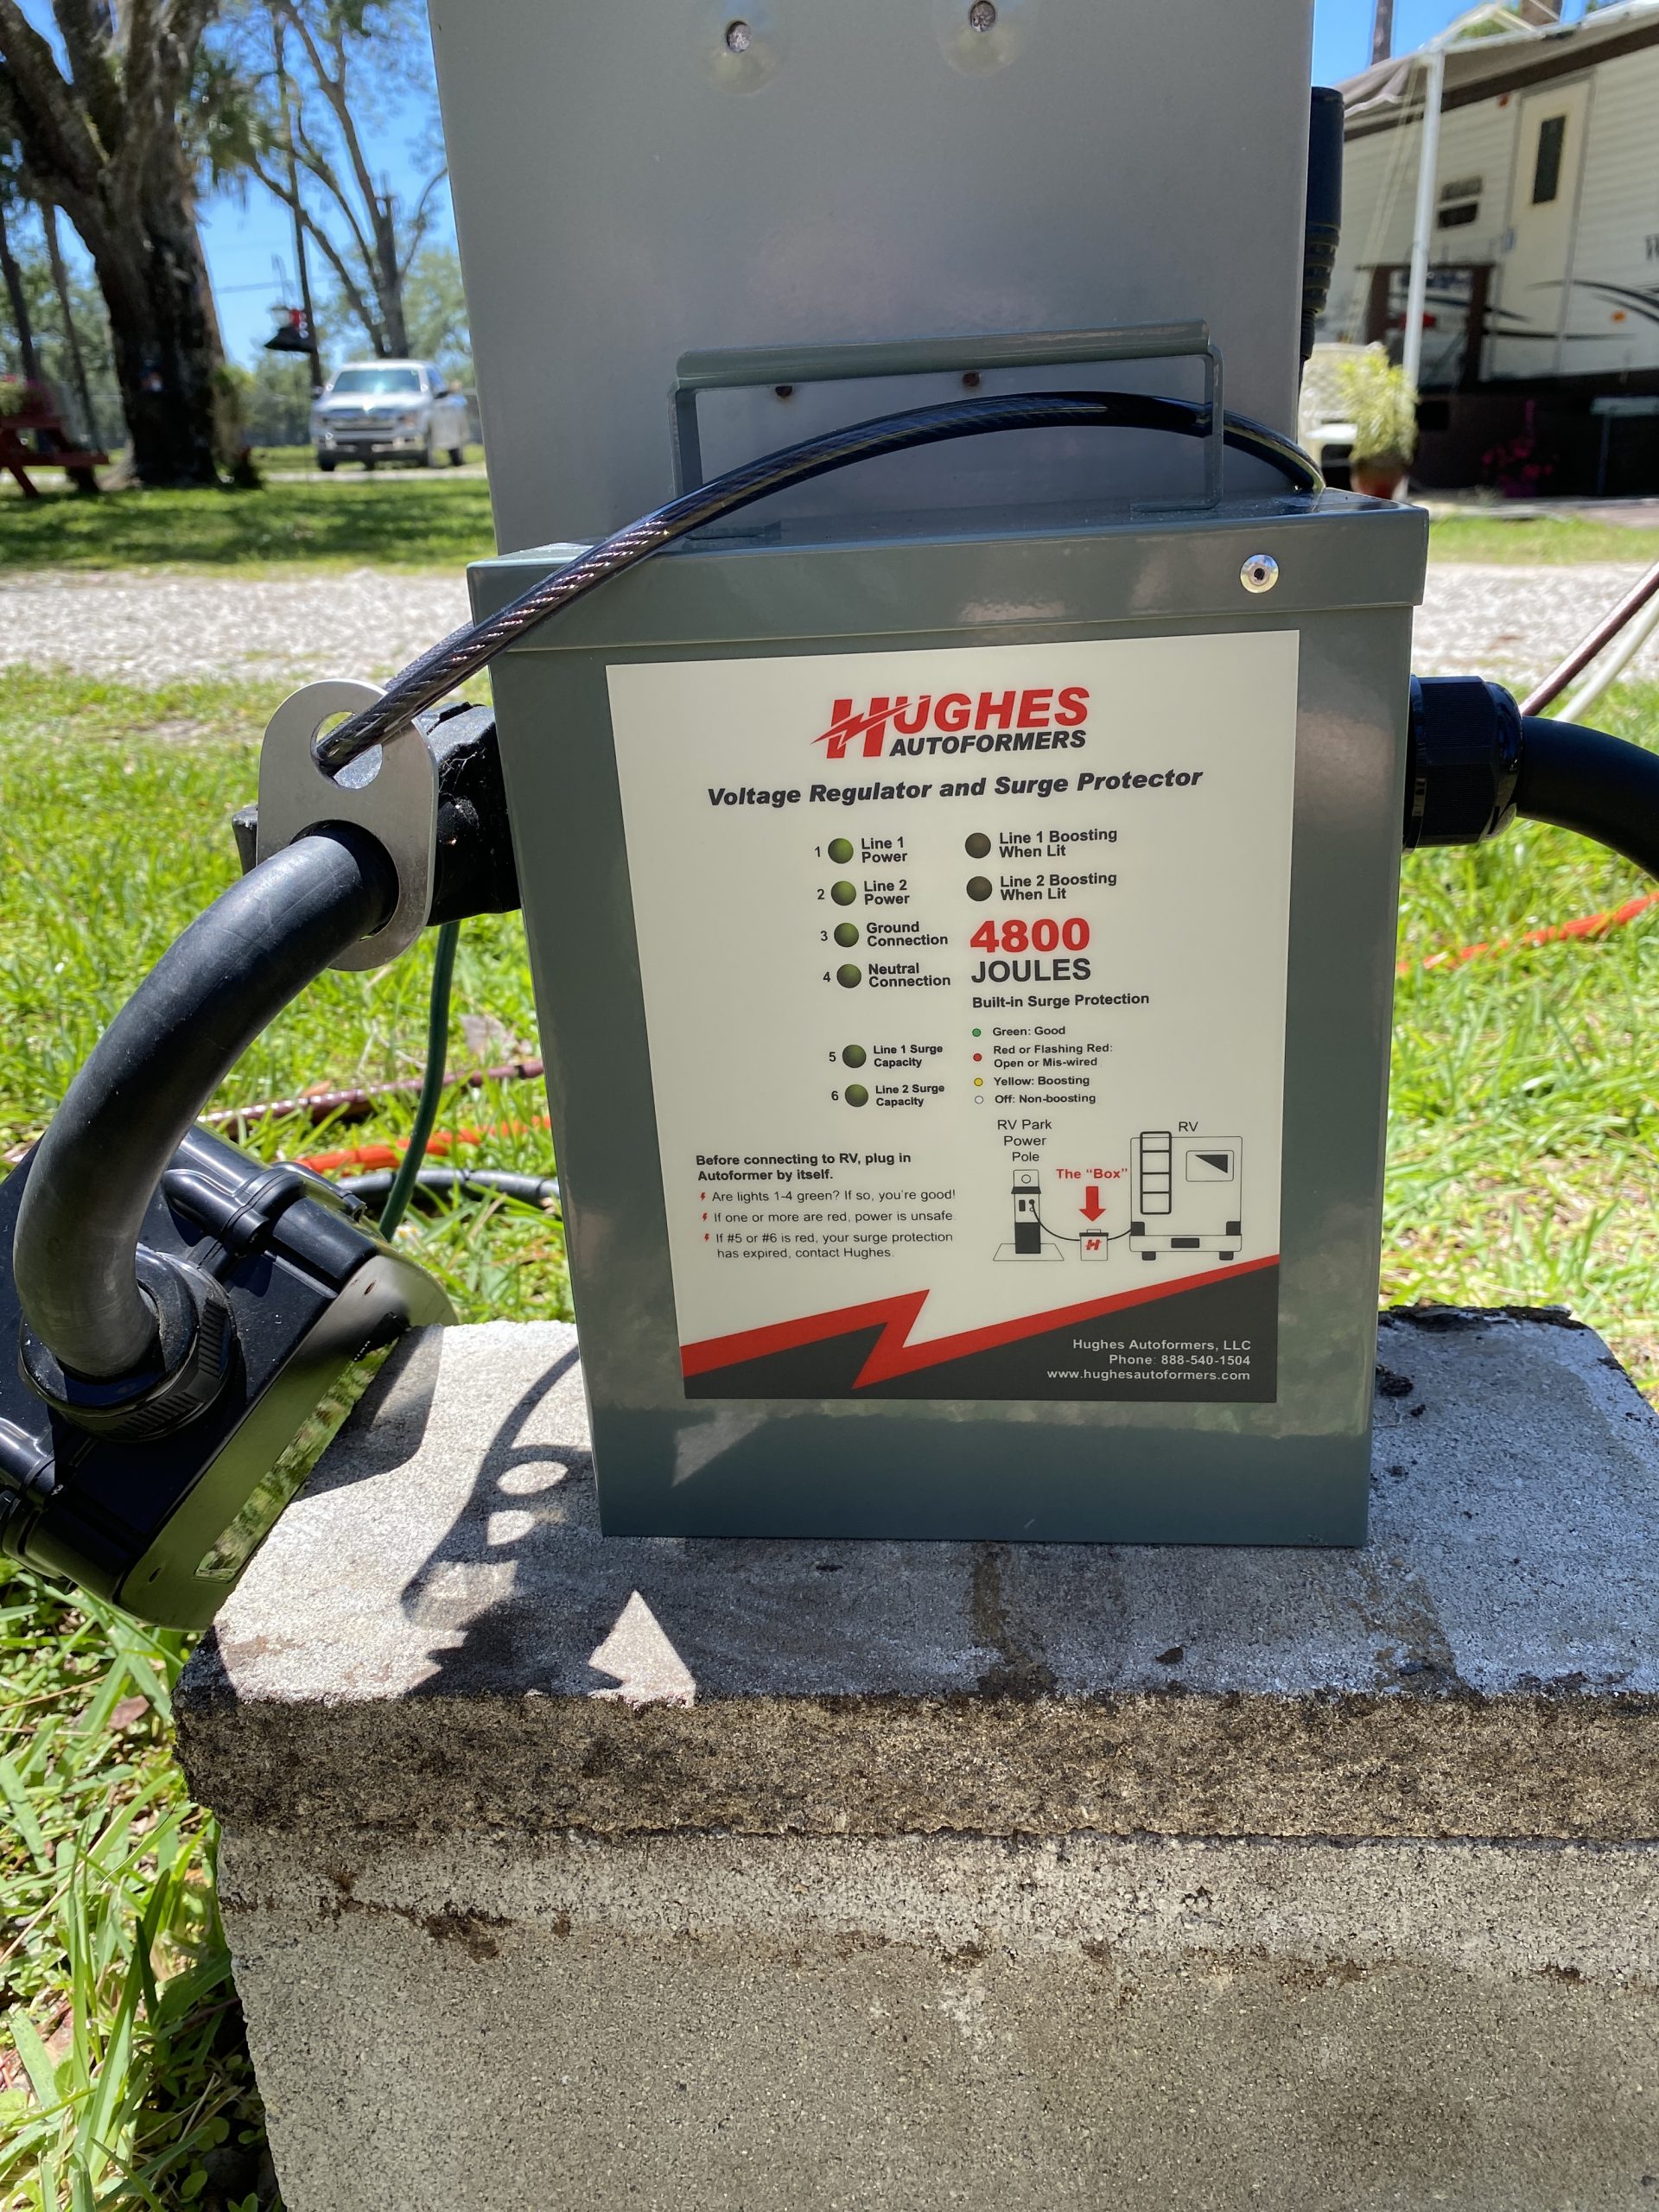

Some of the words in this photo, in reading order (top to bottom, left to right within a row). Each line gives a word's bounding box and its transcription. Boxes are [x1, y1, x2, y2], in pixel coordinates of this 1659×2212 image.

[811, 687, 1090, 759] HUGHES
[889, 730, 1086, 756] AUTOFORMERS
[708, 787, 801, 808] Voltage
[810, 781, 932, 805] Regulator
[939, 778, 987, 797] and
[995, 777, 1068, 798] Surge
[1077, 769, 1204, 791] Protector
[861, 837, 892, 849] Line
[898, 836, 903, 848] 1
[1000, 832, 1031, 844] Line
[1037, 831, 1042, 842] 1
[1050, 829, 1116, 842] Boosting
[815, 846, 820, 857] 1
[999, 846, 1041, 858] When
[1047, 844, 1065, 856] Lit
[862, 852, 907, 863] Power
[864, 880, 894, 892] Line
[899, 880, 907, 890] 2
[1001, 876, 1031, 887] Line
[1037, 875, 1044, 887] 2
[1050, 873, 1116, 886] Boosting
[817, 889, 824, 899] 2
[865, 893, 910, 905] Power
[1001, 889, 1042, 900] When
[1048, 887, 1066, 899] Lit
[867, 921, 919, 933] Ground
[821, 931, 828, 941] 3
[868, 934, 948, 946] Connection
[970, 918, 1090, 953] 4800
[868, 963, 919, 975] Neutral
[971, 958, 1090, 982] JOULES
[823, 972, 830, 982] 4
[869, 975, 950, 988] Connection
[973, 996, 1023, 1007] Built-in
[1028, 995, 1070, 1008] Surge
[1075, 994, 1149, 1005] Protection
[993, 1027, 1030, 1036] Green:
[1034, 1027, 1065, 1035] Good
[874, 1046, 897, 1054] Line
[901, 1045, 906, 1053] 1
[910, 1045, 943, 1055] Surge
[994, 1046, 1015, 1054] Red
[1034, 1045, 1083, 1054] Flashing
[1087, 1044, 1112, 1052] Red:
[830, 1052, 836, 1062] 5
[874, 1058, 922, 1069] Capacity
[995, 1059, 1023, 1070] Open
[1043, 1058, 1096, 1066] Mis-wired
[994, 1077, 1033, 1085] Yellow:
[1038, 1076, 1090, 1086] Boosting
[876, 1085, 899, 1094] Line
[902, 1084, 908, 1093] 2
[912, 1084, 944, 1094] Surge
[831, 1090, 838, 1101] 6
[995, 1095, 1014, 1103] Off:
[1020, 1094, 1096, 1104] Non-boosting
[876, 1097, 924, 1108] Capacity
[998, 1120, 1017, 1129] RV
[1022, 1119, 1052, 1129] Park
[1179, 1122, 1198, 1132] RV
[1004, 1135, 1046, 1146] Power
[696, 1155, 740, 1165] Before
[744, 1154, 817, 1166] connecting
[822, 1154, 835, 1163] to
[840, 1154, 861, 1165] RV,
[866, 1153, 894, 1166] plug
[899, 1153, 911, 1162] in
[1013, 1152, 1039, 1161] Pole
[698, 1170, 772, 1180] Autoformer
[777, 1170, 792, 1182] by
[797, 1169, 833, 1179] itself.
[1056, 1169, 1081, 1179] The
[712, 1192, 733, 1201] Are
[737, 1192, 769, 1204] lights
[774, 1192, 792, 1200] 1-4
[798, 1191, 839, 1203] green?
[845, 1191, 852, 1199] If
[856, 1192, 874, 1201] so,
[879, 1190, 916, 1202] you're
[921, 1190, 955, 1202] good!
[715, 1213, 721, 1222] If
[828, 1211, 850, 1222] red,
[855, 1213, 893, 1224] power
[716, 1234, 723, 1243] If
[728, 1234, 741, 1243] #5
[762, 1233, 777, 1243] #6
[781, 1233, 791, 1243] is
[795, 1233, 817, 1243] red,
[823, 1235, 849, 1244] your
[854, 1235, 887, 1244] surge
[893, 1232, 952, 1244] protection
[717, 1249, 739, 1258] has
[743, 1249, 791, 1260] expired,
[796, 1249, 840, 1257] contact
[1073, 1339, 1124, 1351] Hughes
[1129, 1340, 1218, 1351] Autoformers,
[1224, 1340, 1250, 1350] LLC
[1161, 1355, 1250, 1365] 888-540-1504
[1047, 1370, 1249, 1381] www.hughesautoformers.com
